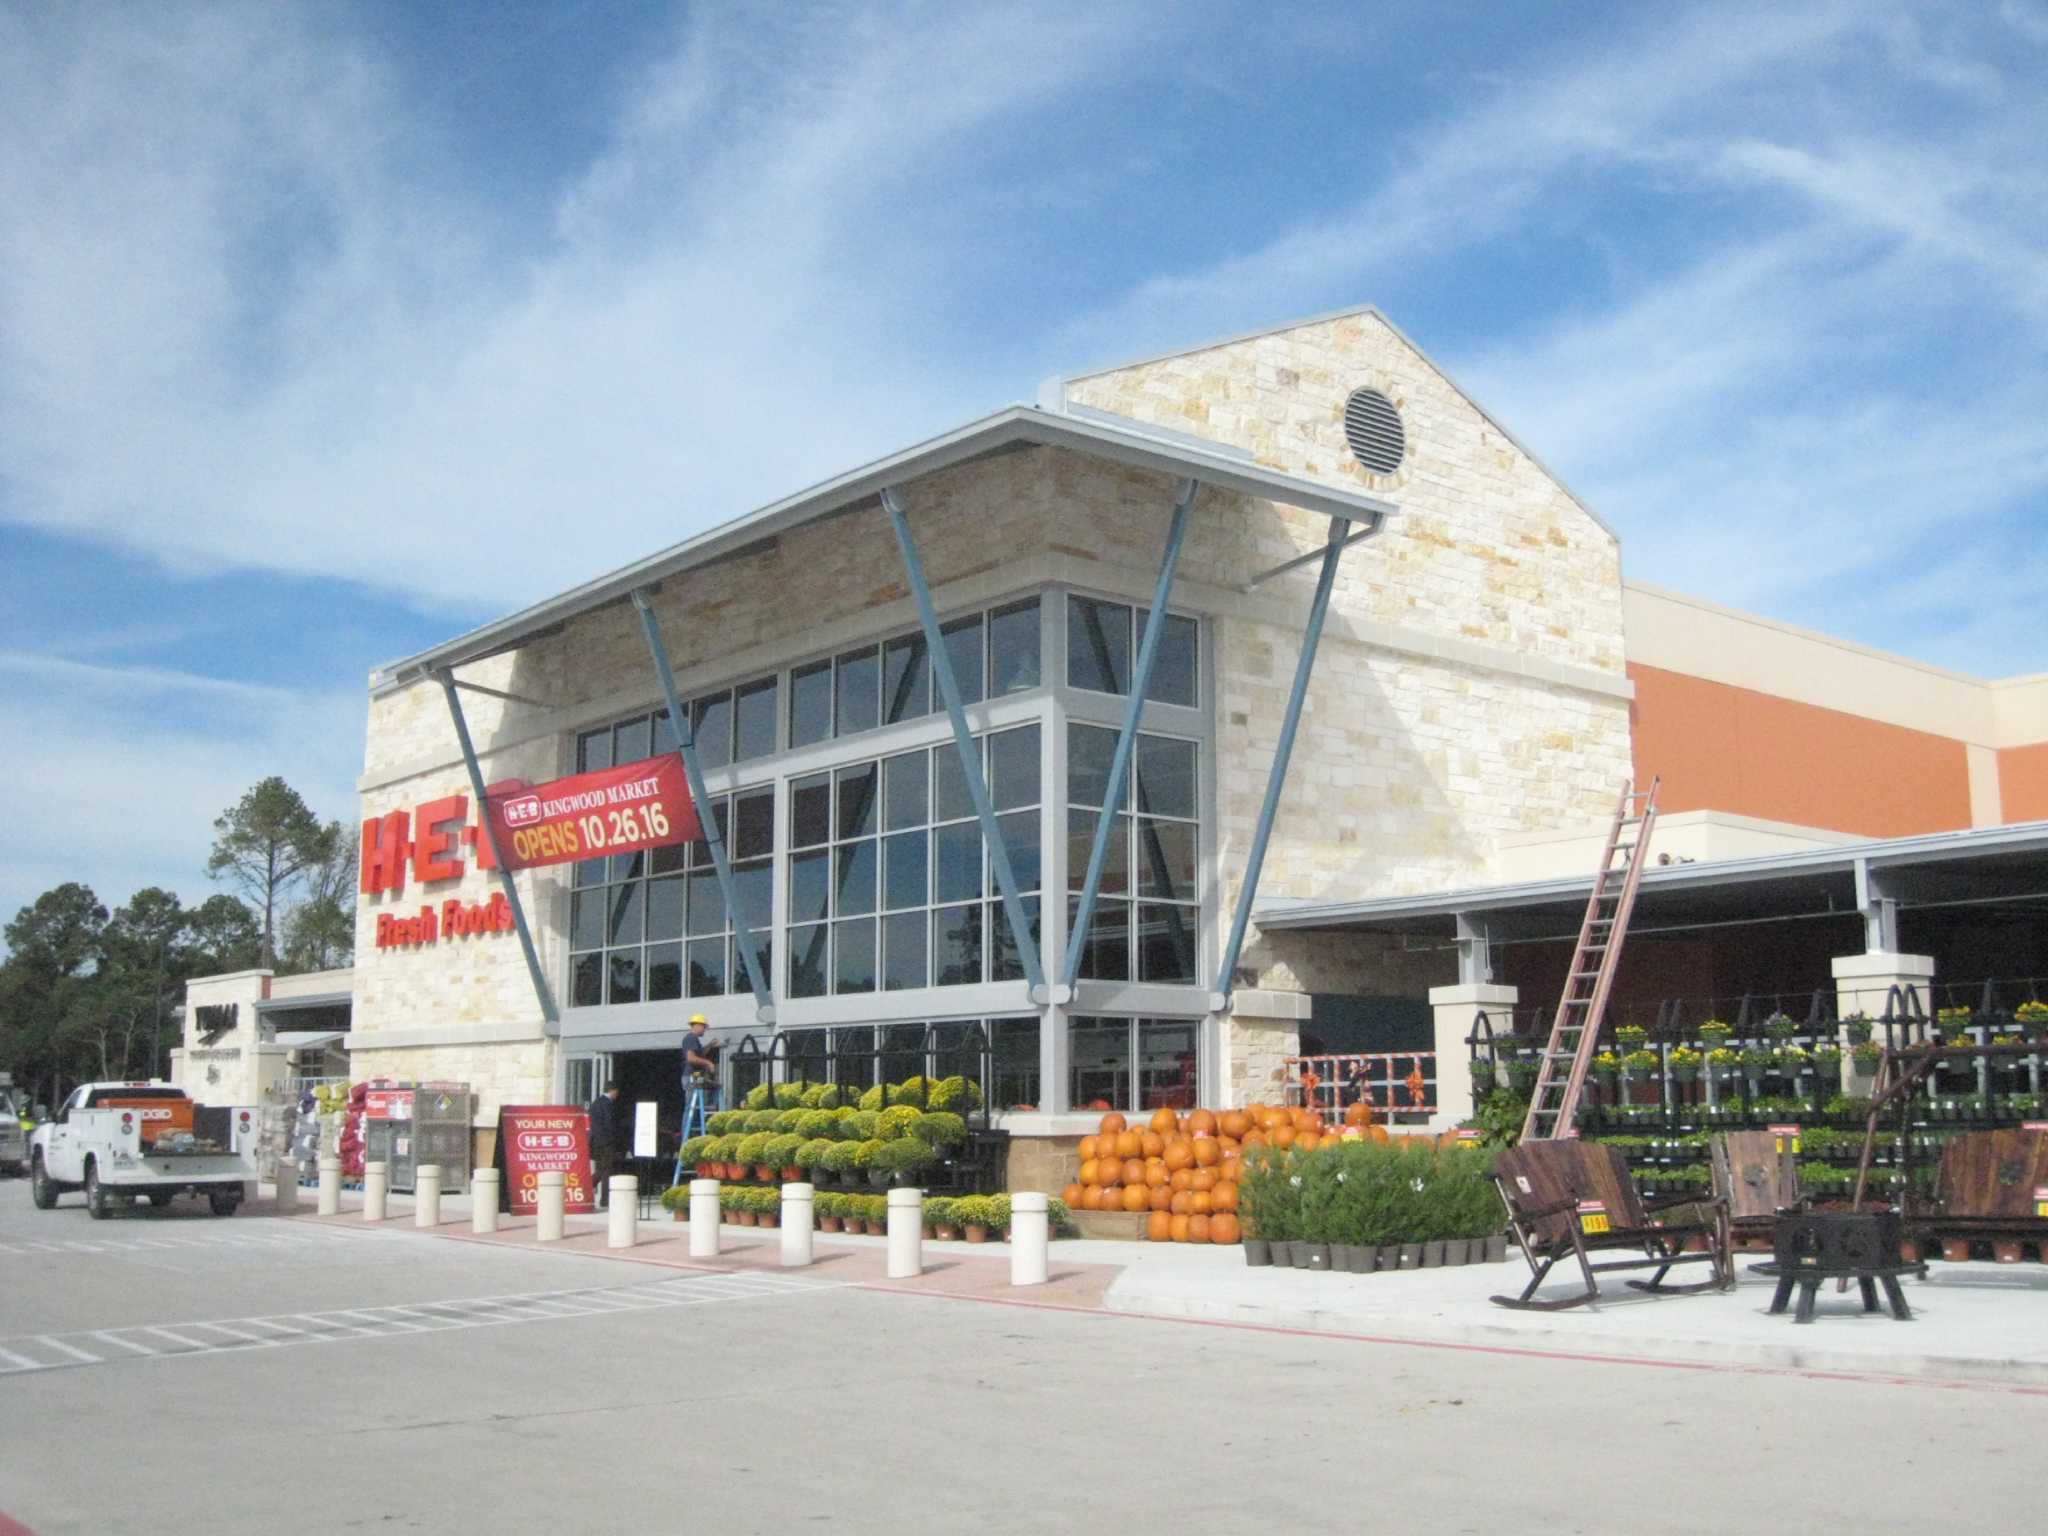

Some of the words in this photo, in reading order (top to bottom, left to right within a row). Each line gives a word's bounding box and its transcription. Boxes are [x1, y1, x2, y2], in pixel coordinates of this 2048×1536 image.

[543, 789, 606, 818] KINGWOOD
[606, 777, 660, 804] MARKET
[513, 820, 580, 862] OPENS
[579, 801, 670, 850] 10.26.16
[376, 904, 438, 949] Fresh
[441, 892, 518, 937] Foods
[515, 1119, 546, 1129] YOUR
[548, 1119, 574, 1129] NEW
[519, 1152, 578, 1161] KINGWOOD
[527, 1161, 572, 1171] MARKET
[520, 1187, 585, 1203] 10.16
